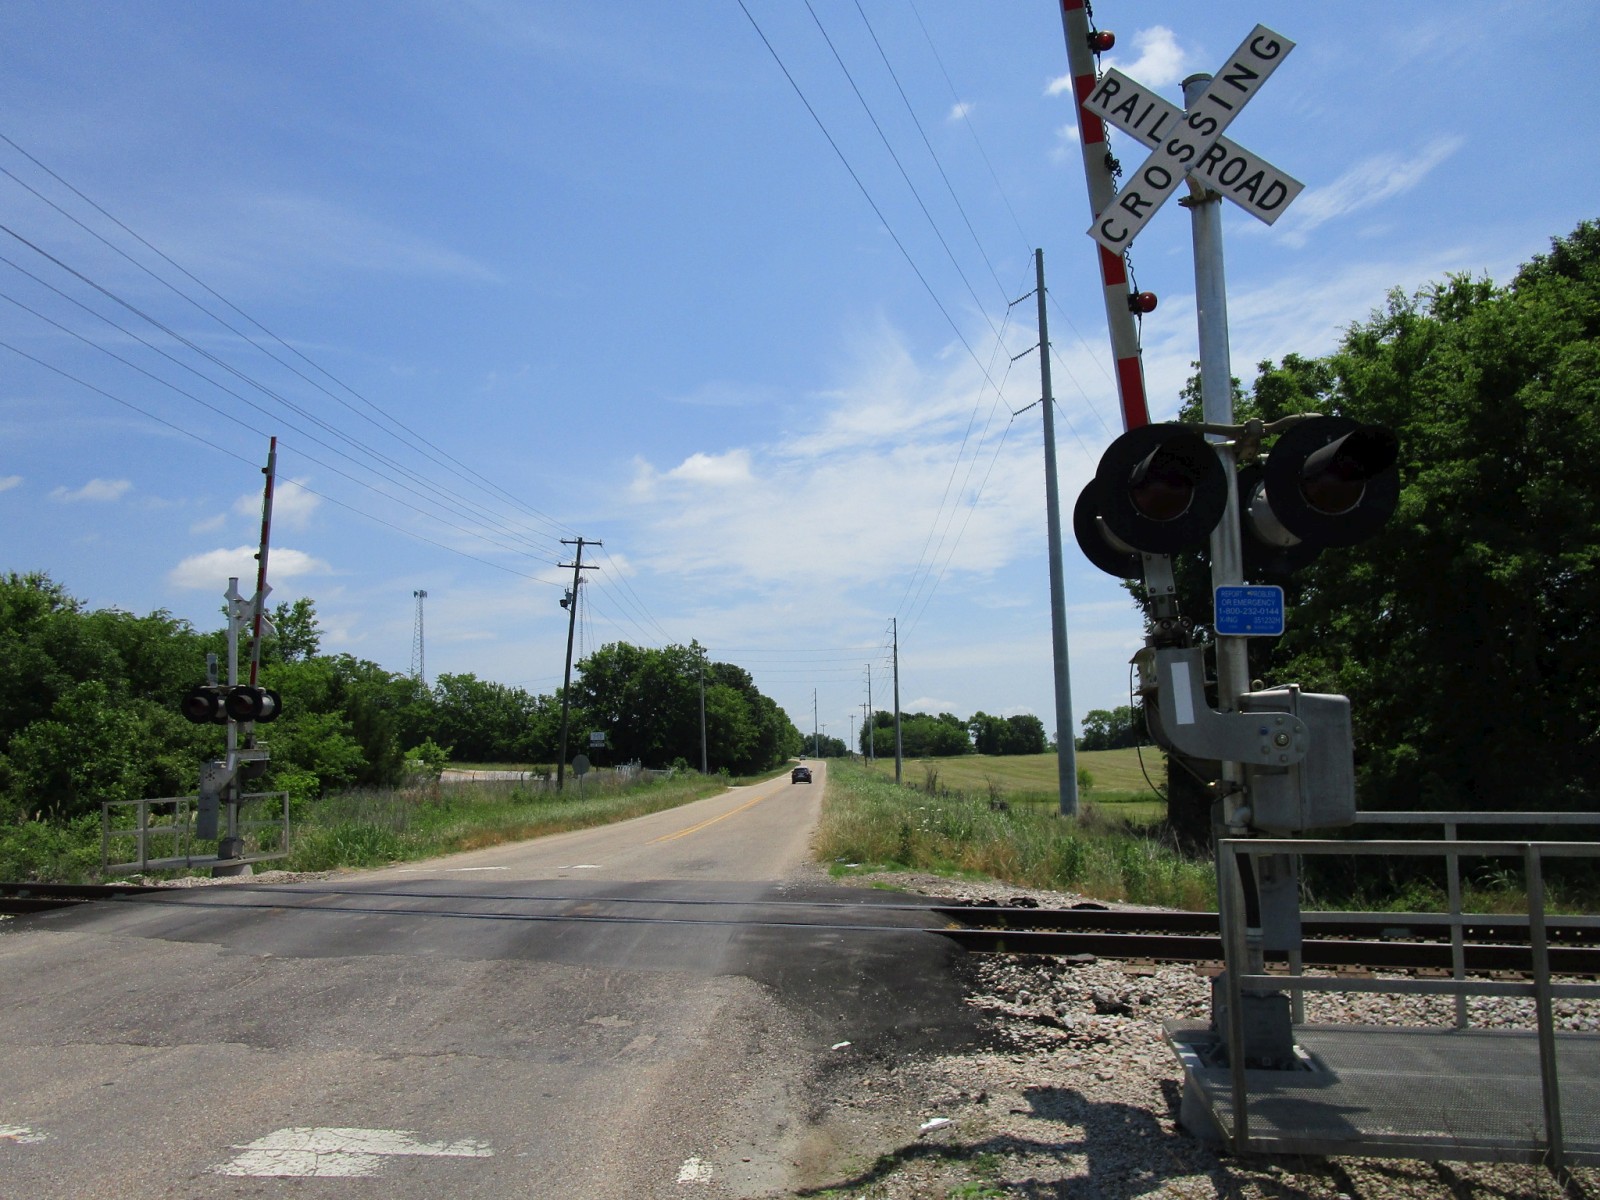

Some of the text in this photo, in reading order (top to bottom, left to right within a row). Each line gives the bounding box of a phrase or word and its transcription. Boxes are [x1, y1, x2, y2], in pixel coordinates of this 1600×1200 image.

[1092, 77, 1287, 210] RAIL ROAD
[1101, 35, 1281, 243] CROSSING
[1219, 607, 1279, 615] 1-800-232-0144
